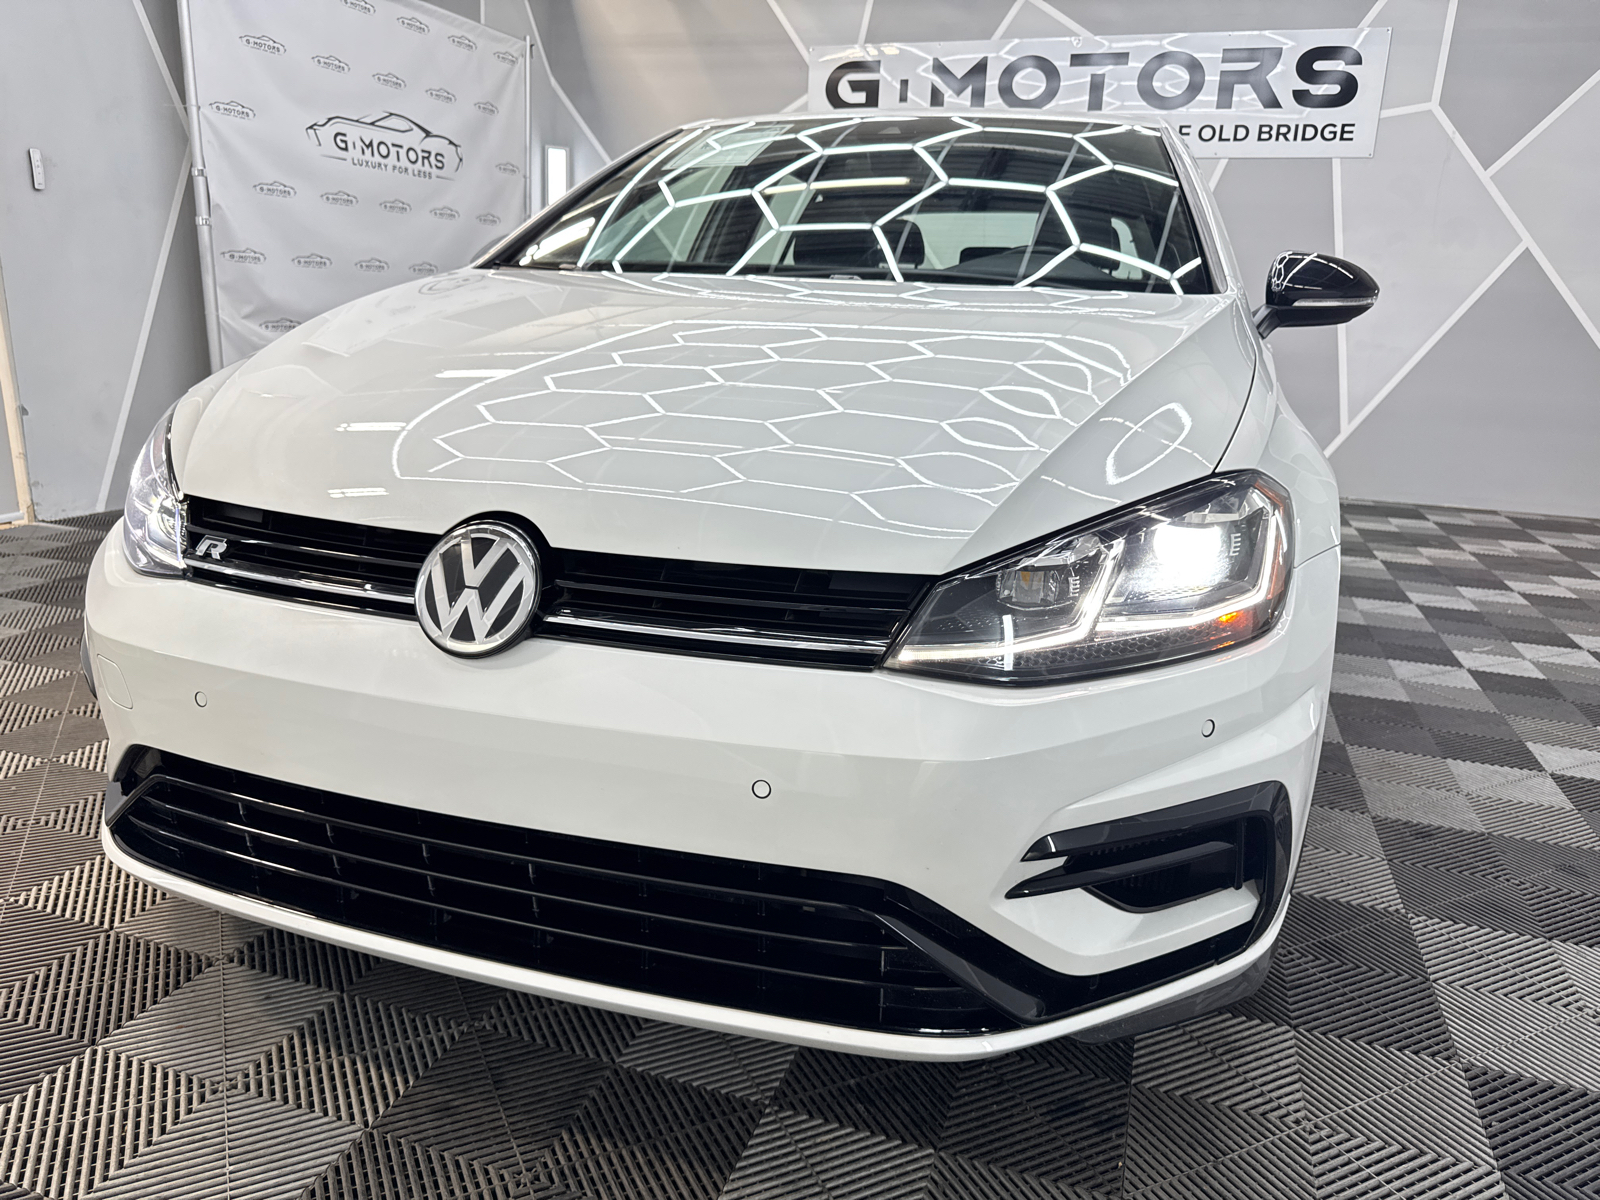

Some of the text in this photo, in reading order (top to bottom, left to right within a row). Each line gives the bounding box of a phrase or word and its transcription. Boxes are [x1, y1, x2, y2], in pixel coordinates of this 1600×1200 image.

[1198, 124, 1250, 142] OLD
[1257, 123, 1356, 142] BRIDGE
[360, 136, 445, 170] MOTORS
[352, 157, 433, 180] LUXURY FOR LESS
[195, 534, 228, 561] R
